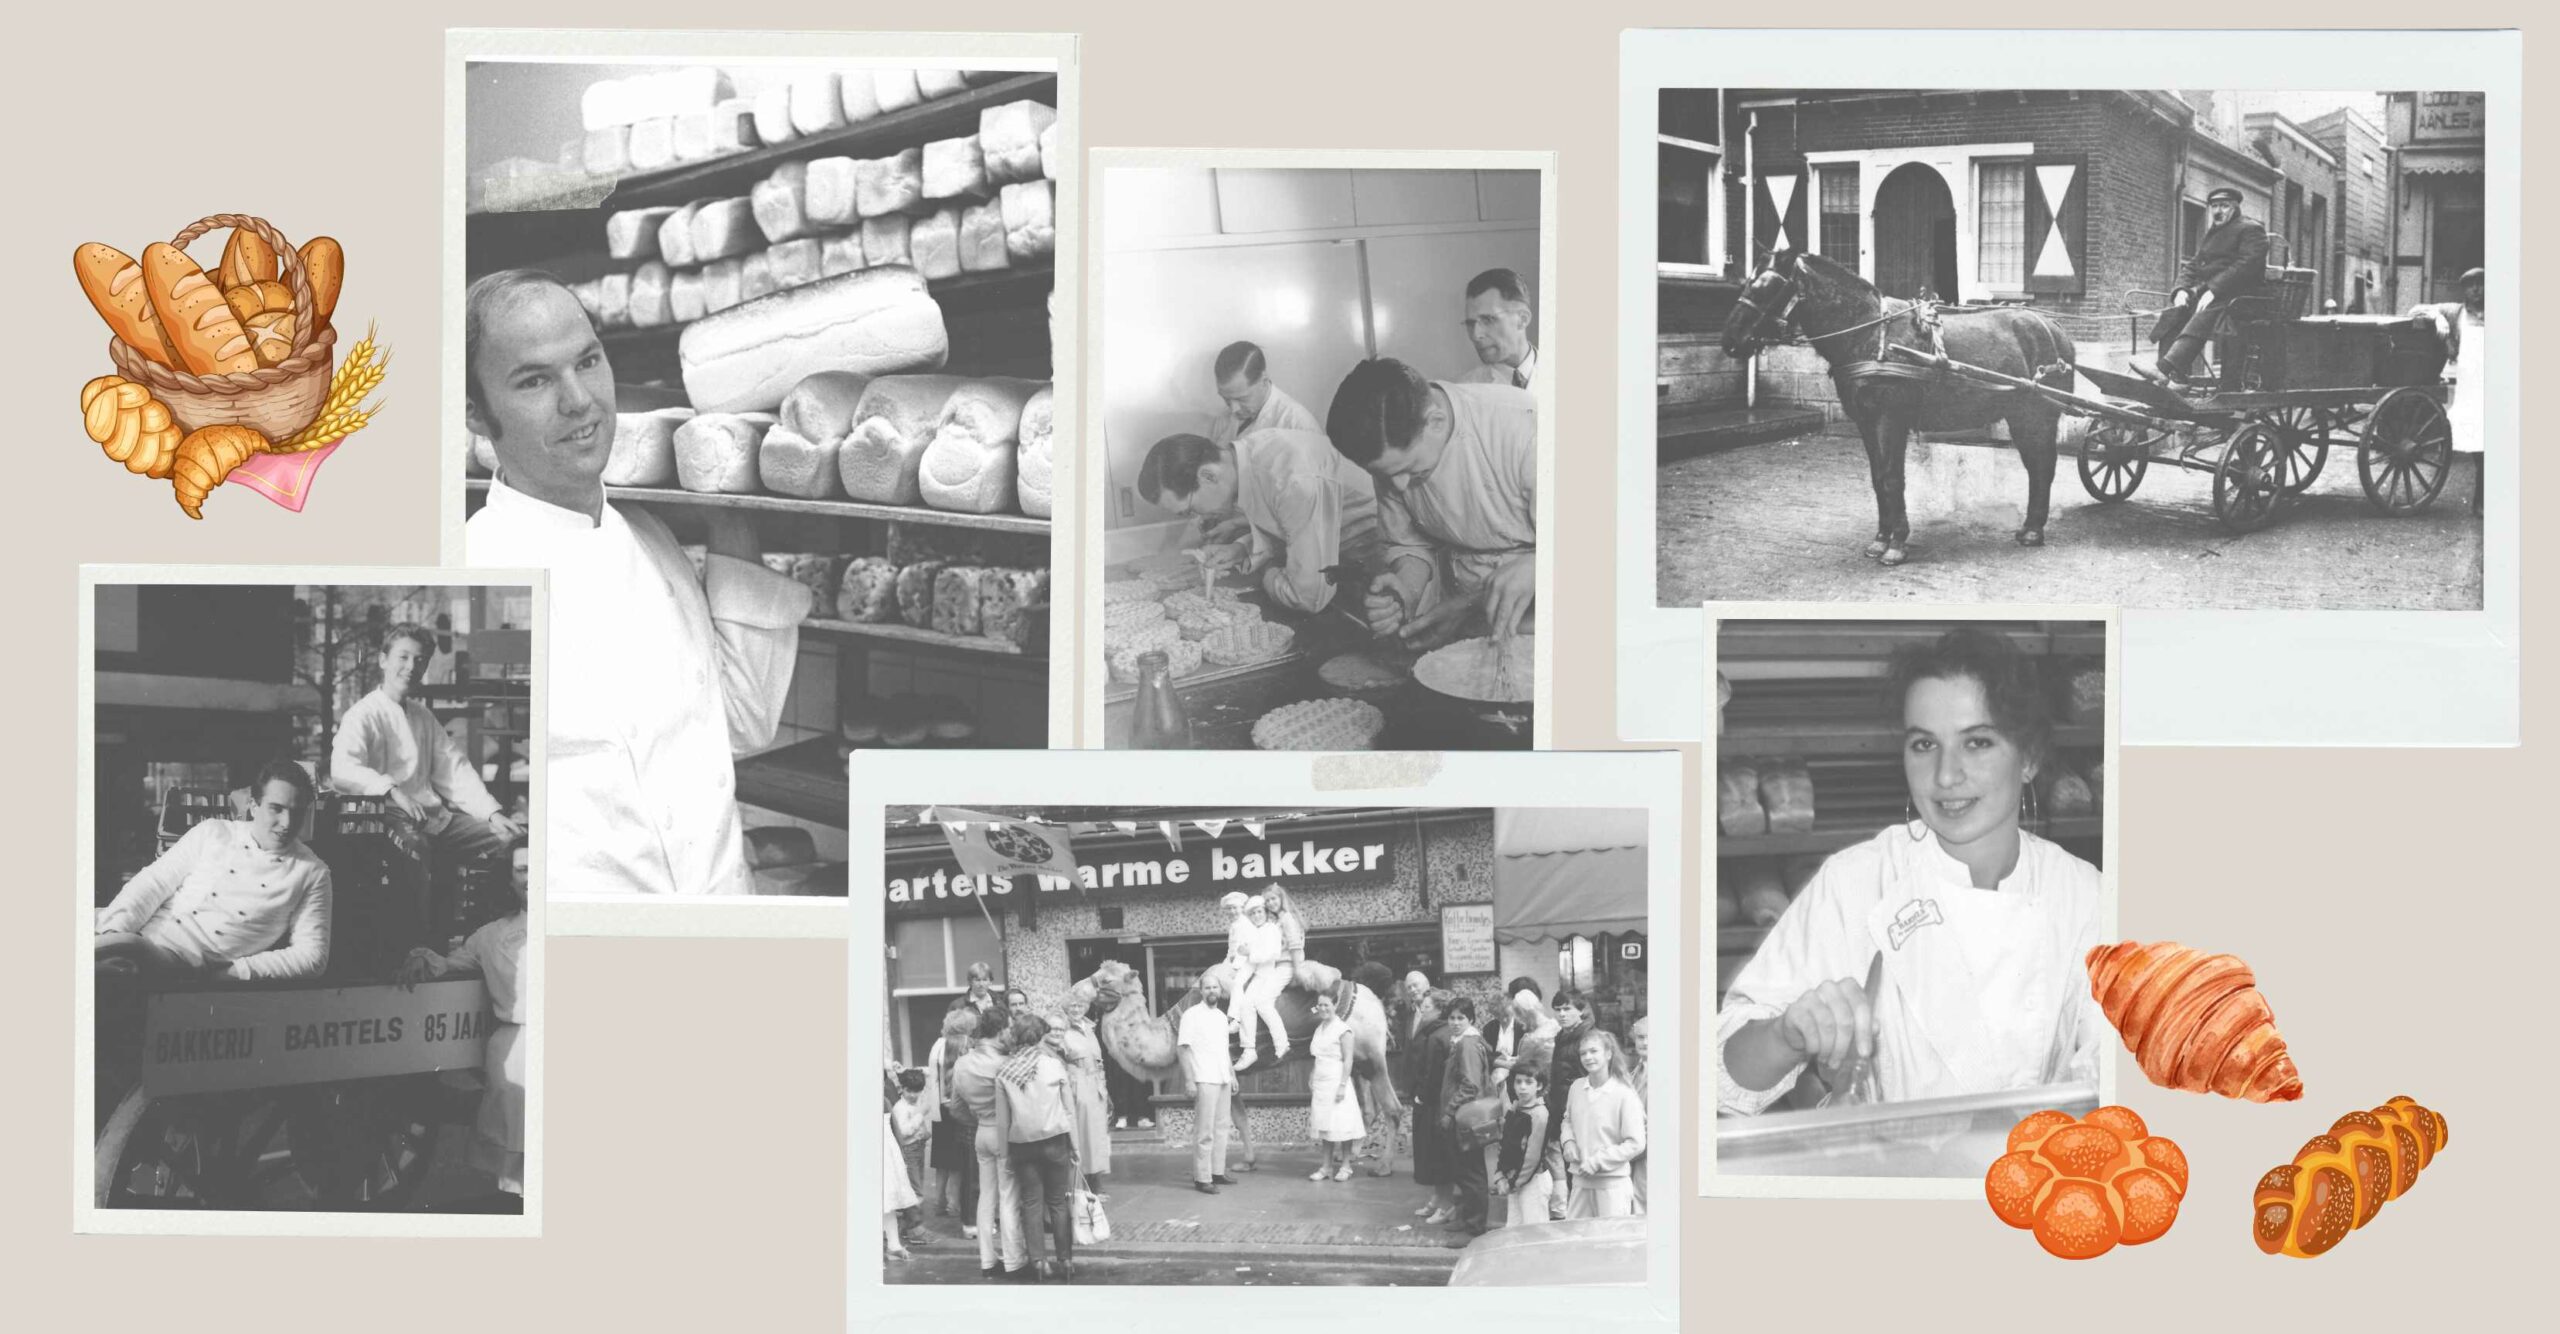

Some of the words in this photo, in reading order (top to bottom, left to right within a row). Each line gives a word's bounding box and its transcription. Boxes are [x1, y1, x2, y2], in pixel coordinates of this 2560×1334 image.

[885, 868, 1013, 902] artels
[1037, 859, 1190, 891] warme
[1212, 841, 1384, 880] bakker
[155, 1027, 254, 1064] BAKKERIJ
[285, 1017, 404, 1051] BARTELS
[424, 1014, 447, 1042] 85
